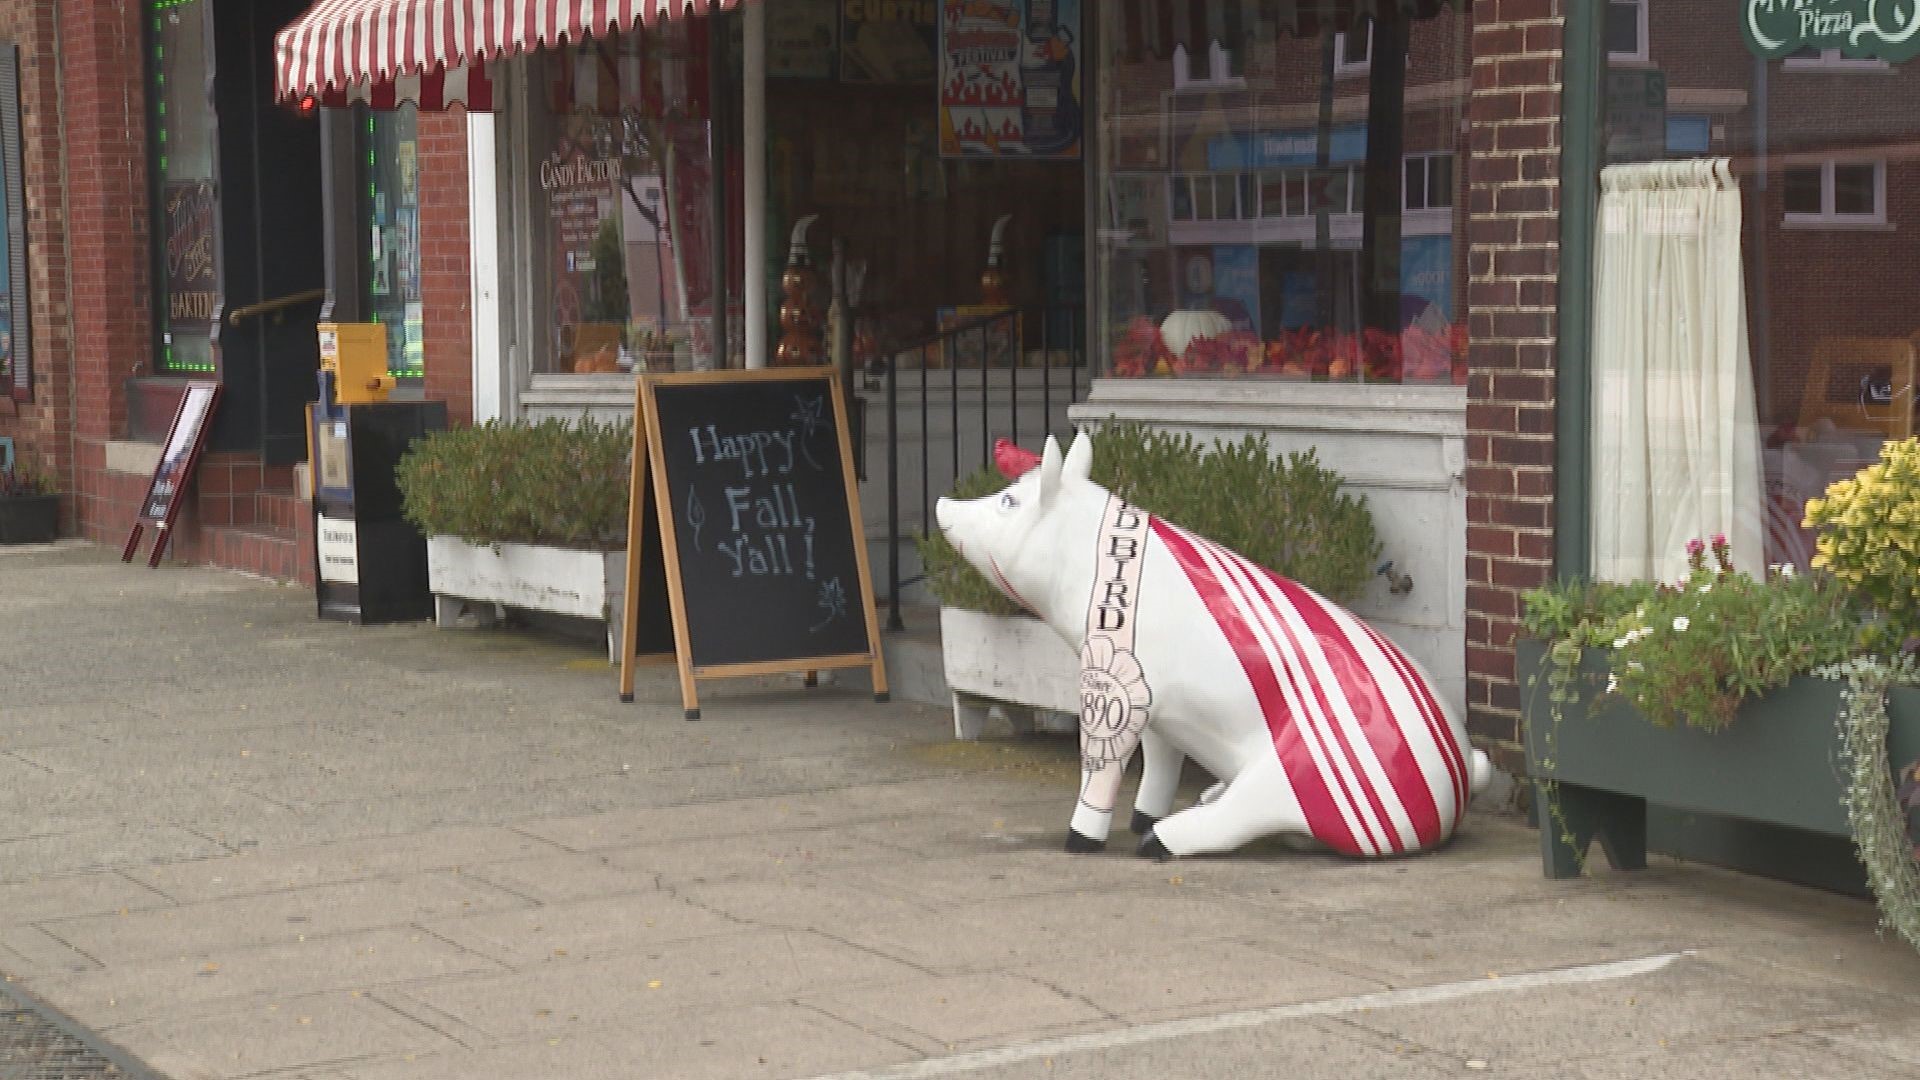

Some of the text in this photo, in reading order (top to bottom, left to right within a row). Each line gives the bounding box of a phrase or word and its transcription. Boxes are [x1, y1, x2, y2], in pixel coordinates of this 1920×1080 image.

[1799, 9, 1853, 37] Pizza
[540, 160, 577, 190] CANDY
[689, 424, 796, 478] Happy
[724, 483, 816, 532] Fall,
